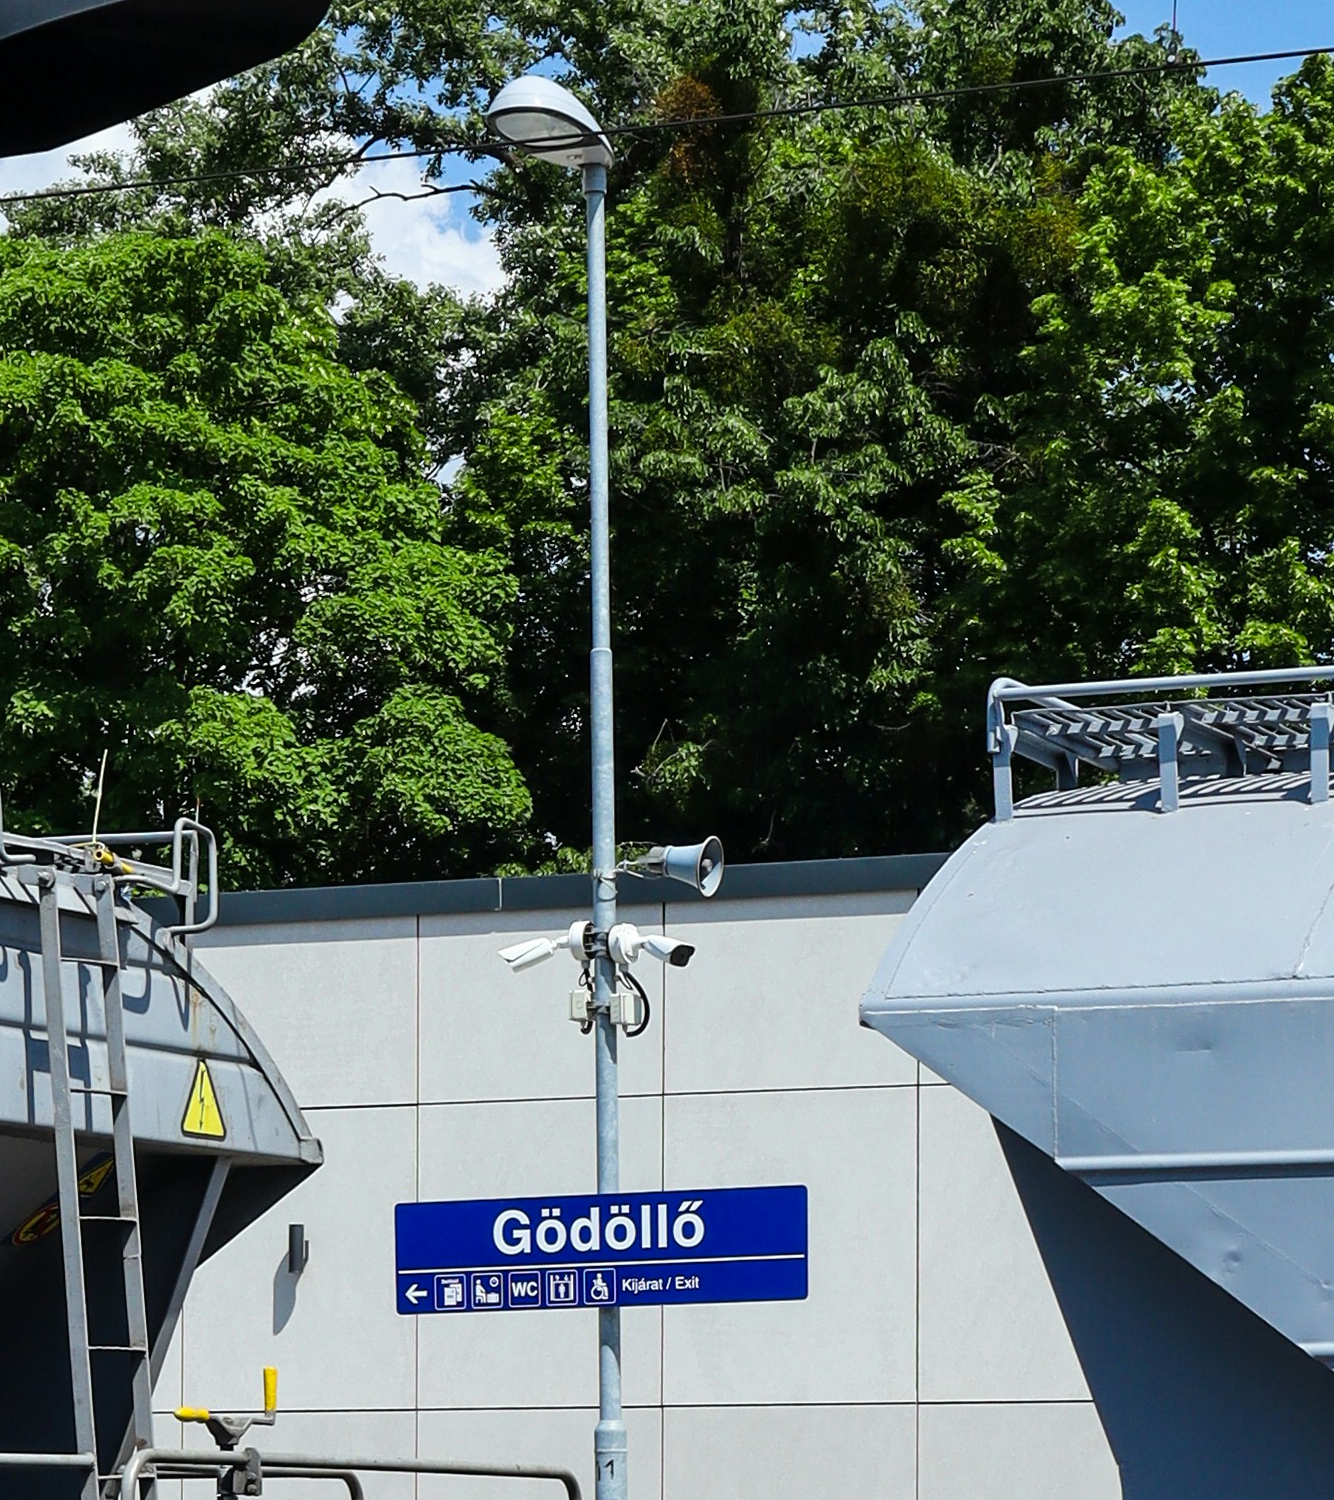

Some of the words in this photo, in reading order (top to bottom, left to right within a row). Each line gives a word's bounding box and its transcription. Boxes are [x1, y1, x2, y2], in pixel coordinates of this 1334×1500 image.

[492, 1199, 705, 1255] Gödöllő
[510, 1281, 538, 1299] WC
[674, 1275, 700, 1290] Exit
